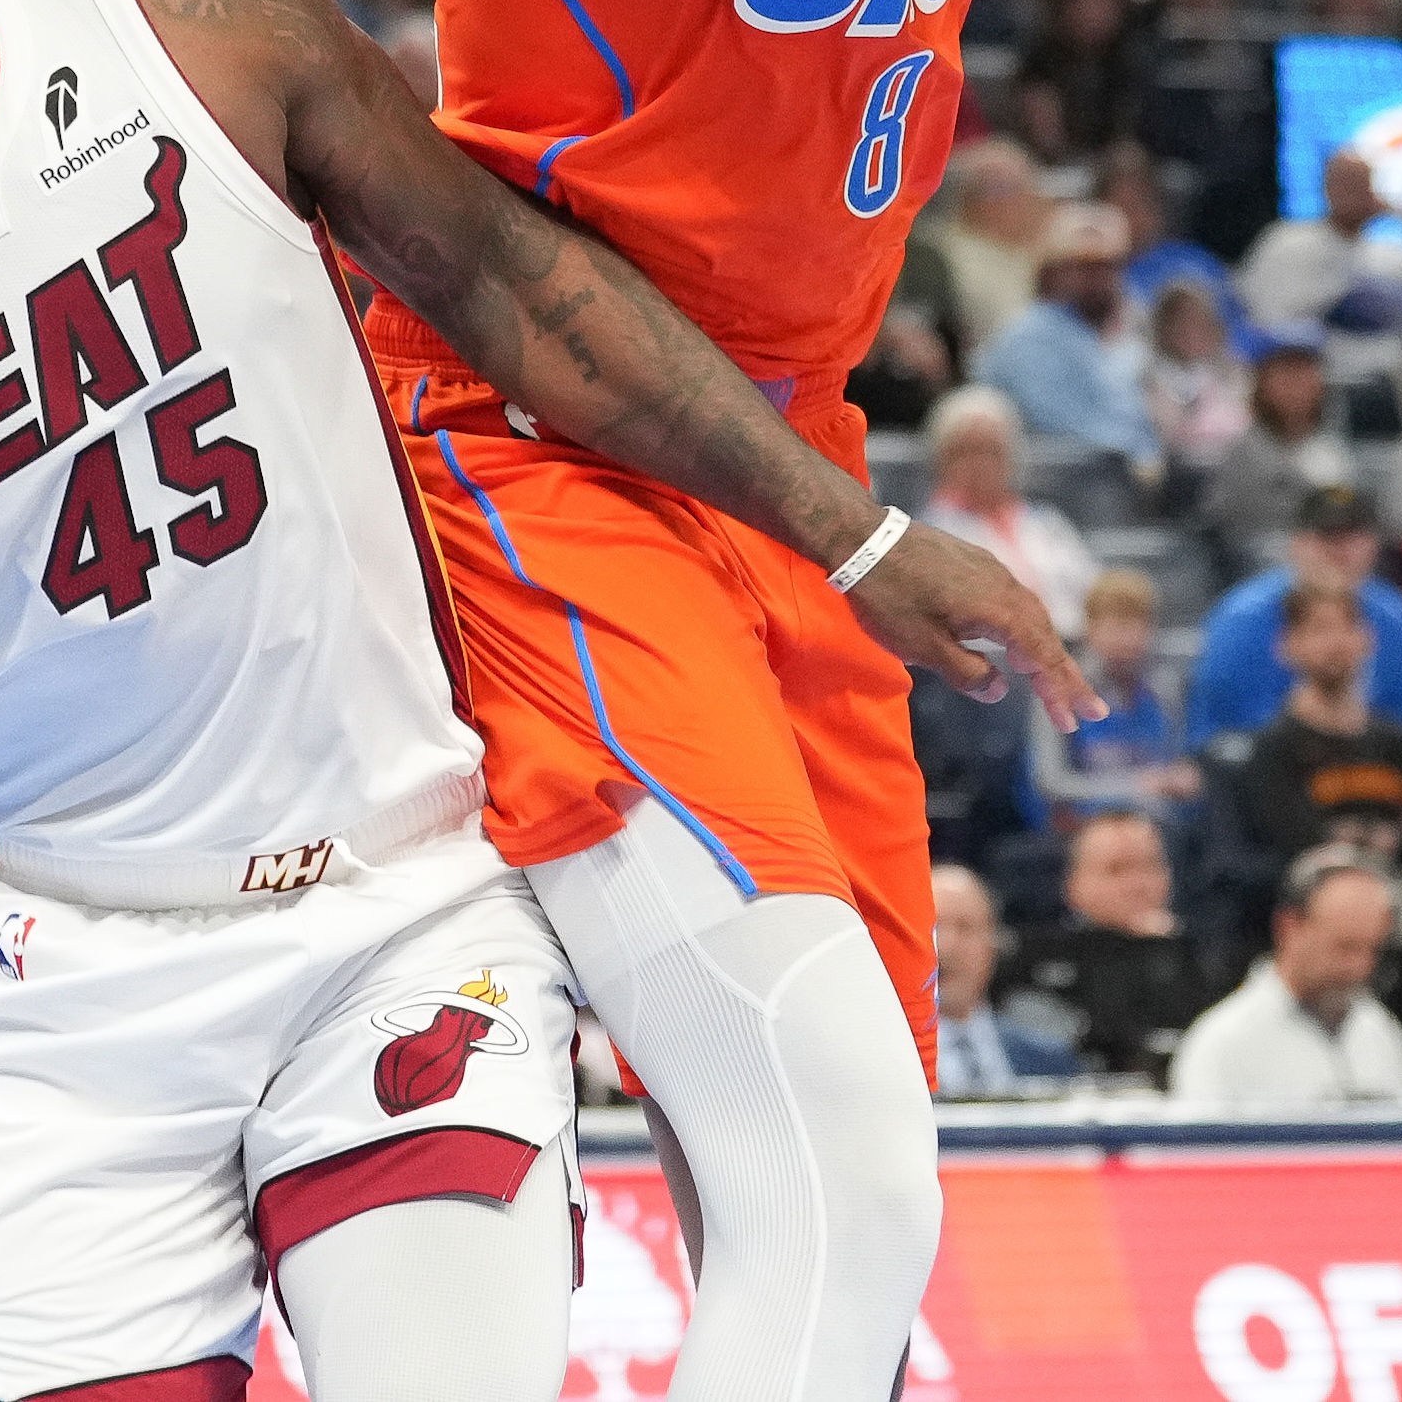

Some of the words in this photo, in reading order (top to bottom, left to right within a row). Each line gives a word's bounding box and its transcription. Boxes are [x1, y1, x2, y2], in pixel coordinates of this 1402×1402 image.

[39, 108, 151, 190] Robinhood
[844, 49, 935, 220] 8
[41, 366, 269, 620] 45
